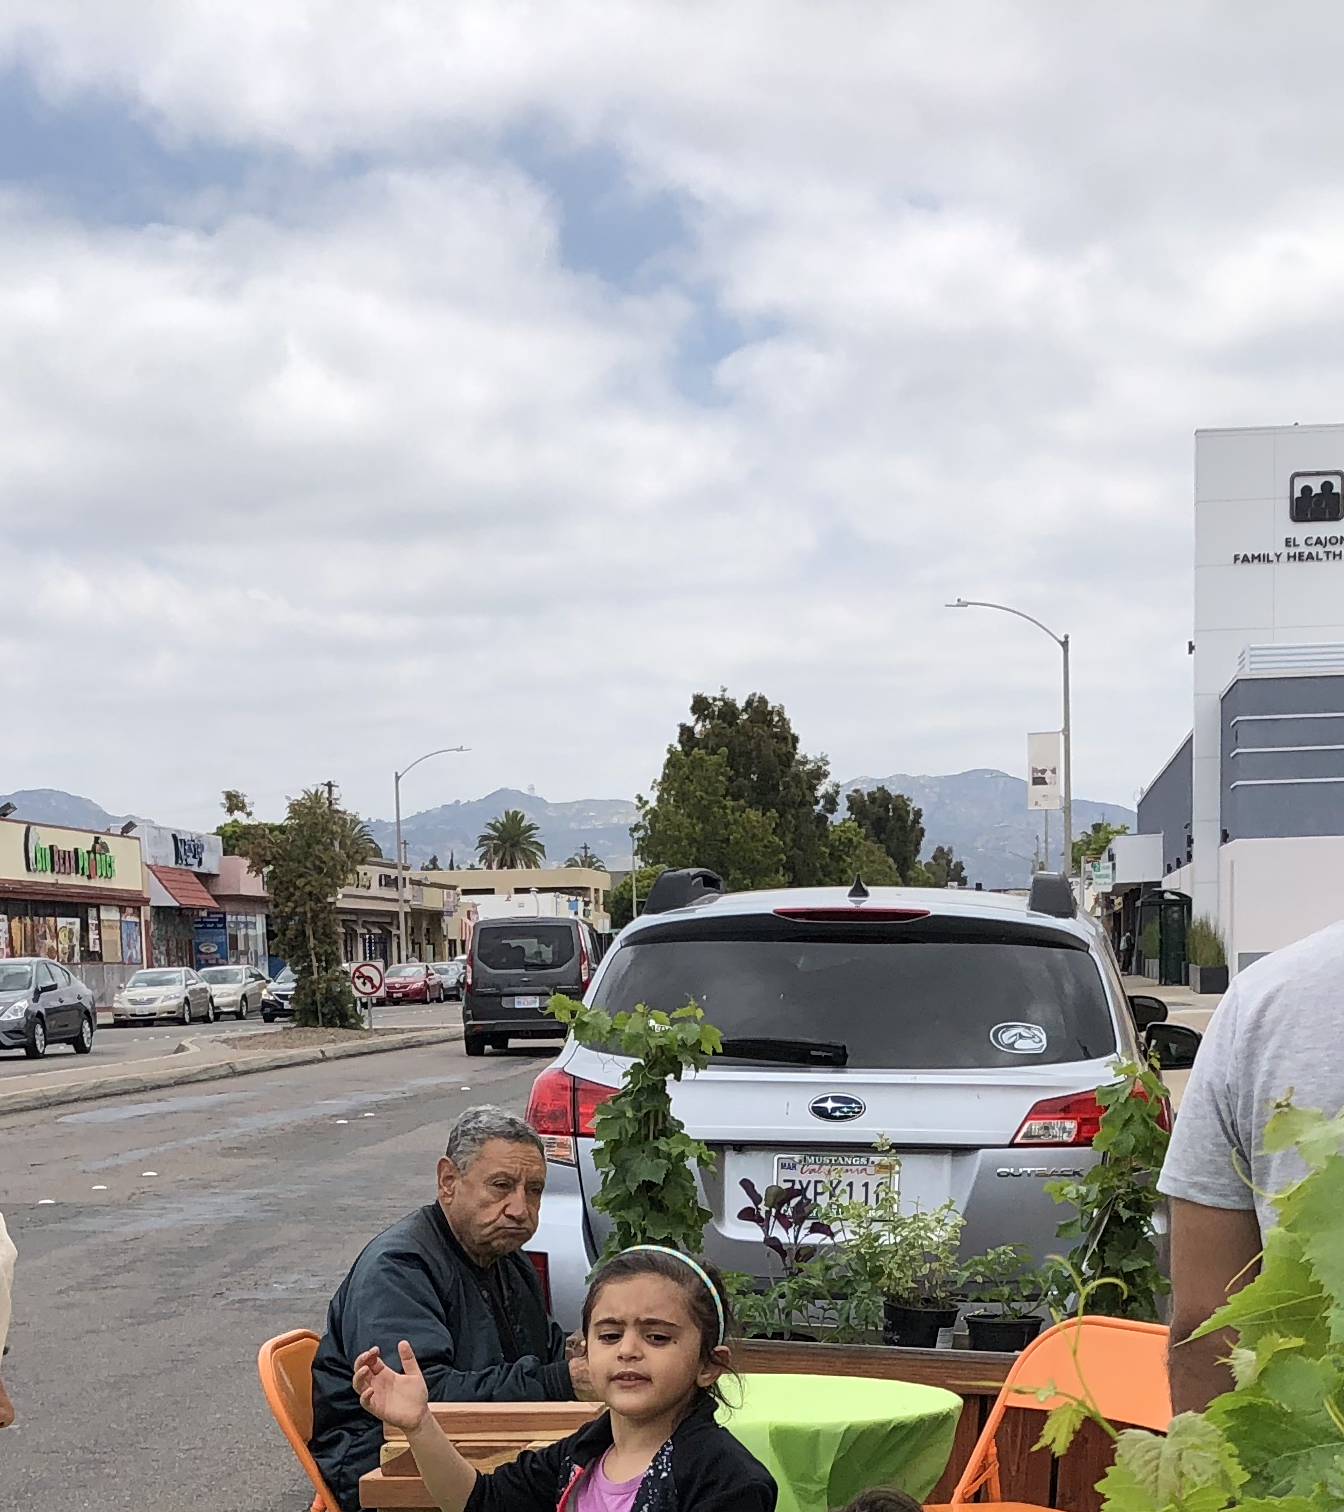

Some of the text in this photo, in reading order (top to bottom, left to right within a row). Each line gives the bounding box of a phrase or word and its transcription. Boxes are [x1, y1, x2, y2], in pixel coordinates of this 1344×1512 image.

[1284, 536, 1300, 548] EL
[1233, 551, 1282, 565] FAMILY
[1286, 550, 1343, 562] HEALTH
[806, 1155, 868, 1165] MUSTANGS
[996, 1167, 1085, 1178] OUTBACK
